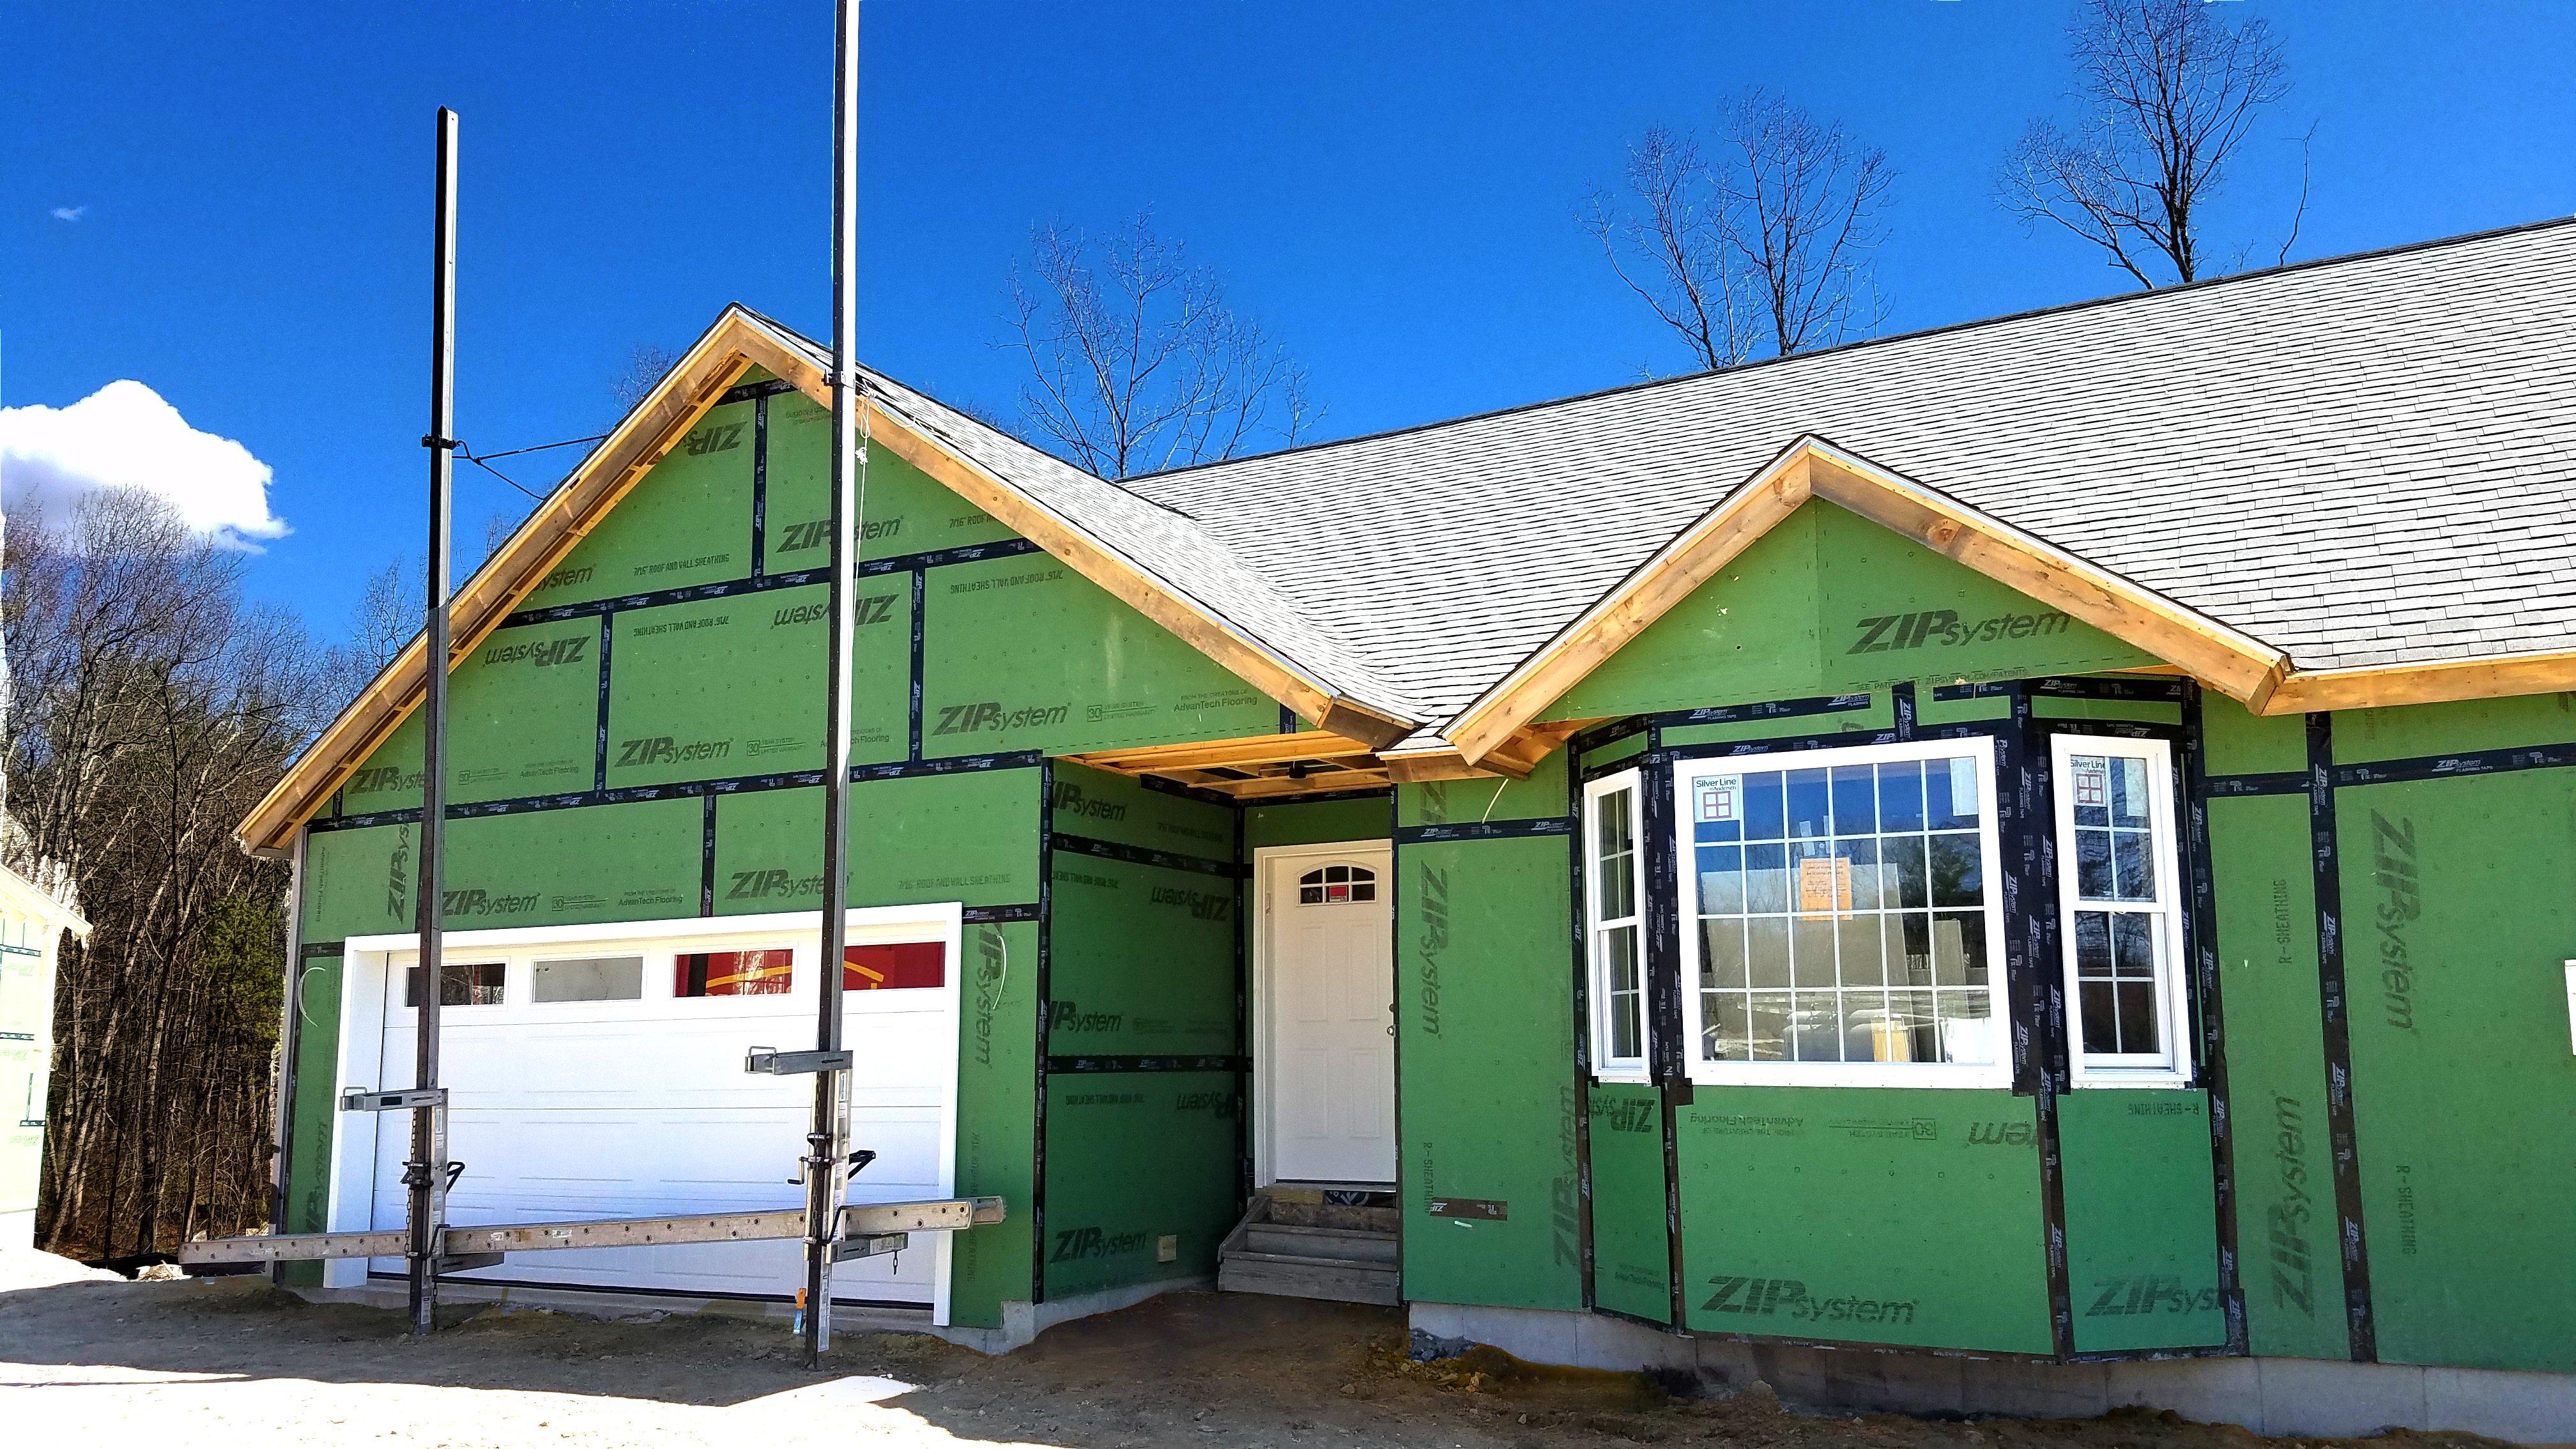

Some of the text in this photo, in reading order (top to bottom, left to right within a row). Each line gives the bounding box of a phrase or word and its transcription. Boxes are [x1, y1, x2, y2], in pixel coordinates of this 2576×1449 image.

[967, 514, 986, 526] ROOF
[649, 565, 665, 574] ROOF
[665, 562, 678, 571] AND
[678, 560, 694, 569] WALL
[695, 553, 730, 566] SHEATHING
[990, 578, 1009, 588] WALL
[1010, 575, 1025, 586] AND
[1023, 572, 1045, 584] ROOF
[950, 580, 990, 594] SHEATHING
[684, 620, 697, 630] AND
[696, 618, 714, 628] ROOF
[634, 624, 667, 638] SHEATHING
[1846, 609, 2072, 656] ZIPsystem
[485, 636, 590, 667] ZIPsystem
[1856, 682, 1871, 691] SEE
[1174, 696, 1257, 712] AdvanTech Flooring
[932, 702, 1068, 735] ZIPsystem
[1089, 707, 1101, 719] 30
[860, 734, 889, 744] Flooring
[614, 737, 730, 767] ZIPsystem
[748, 743, 759, 753] 30
[2071, 759, 2090, 768] Silver
[349, 767, 426, 795] ZIPsyste
[1696, 778, 1736, 788] Silver Line
[916, 879, 935, 889] ROOF
[935, 878, 949, 888] AND
[950, 877, 969, 887] WALL
[969, 874, 1011, 885] SHEATHING
[618, 896, 683, 906] AdvanTech Flooring
[2273, 878, 2292, 964] R-SHEATHING
[2370, 808, 2421, 1029] ZIPsystem
[1420, 860, 1448, 1034] ZIPsystem
[2128, 1102, 2199, 1116] R-SHEATHING
[2267, 1096, 2315, 1321] ZIPsystem
[2396, 1165, 2418, 1255] R-SHEATHING
[1050, 1226, 1146, 1264] ZIPsystem
[1700, 1276, 1913, 1326] ZIPsystem
